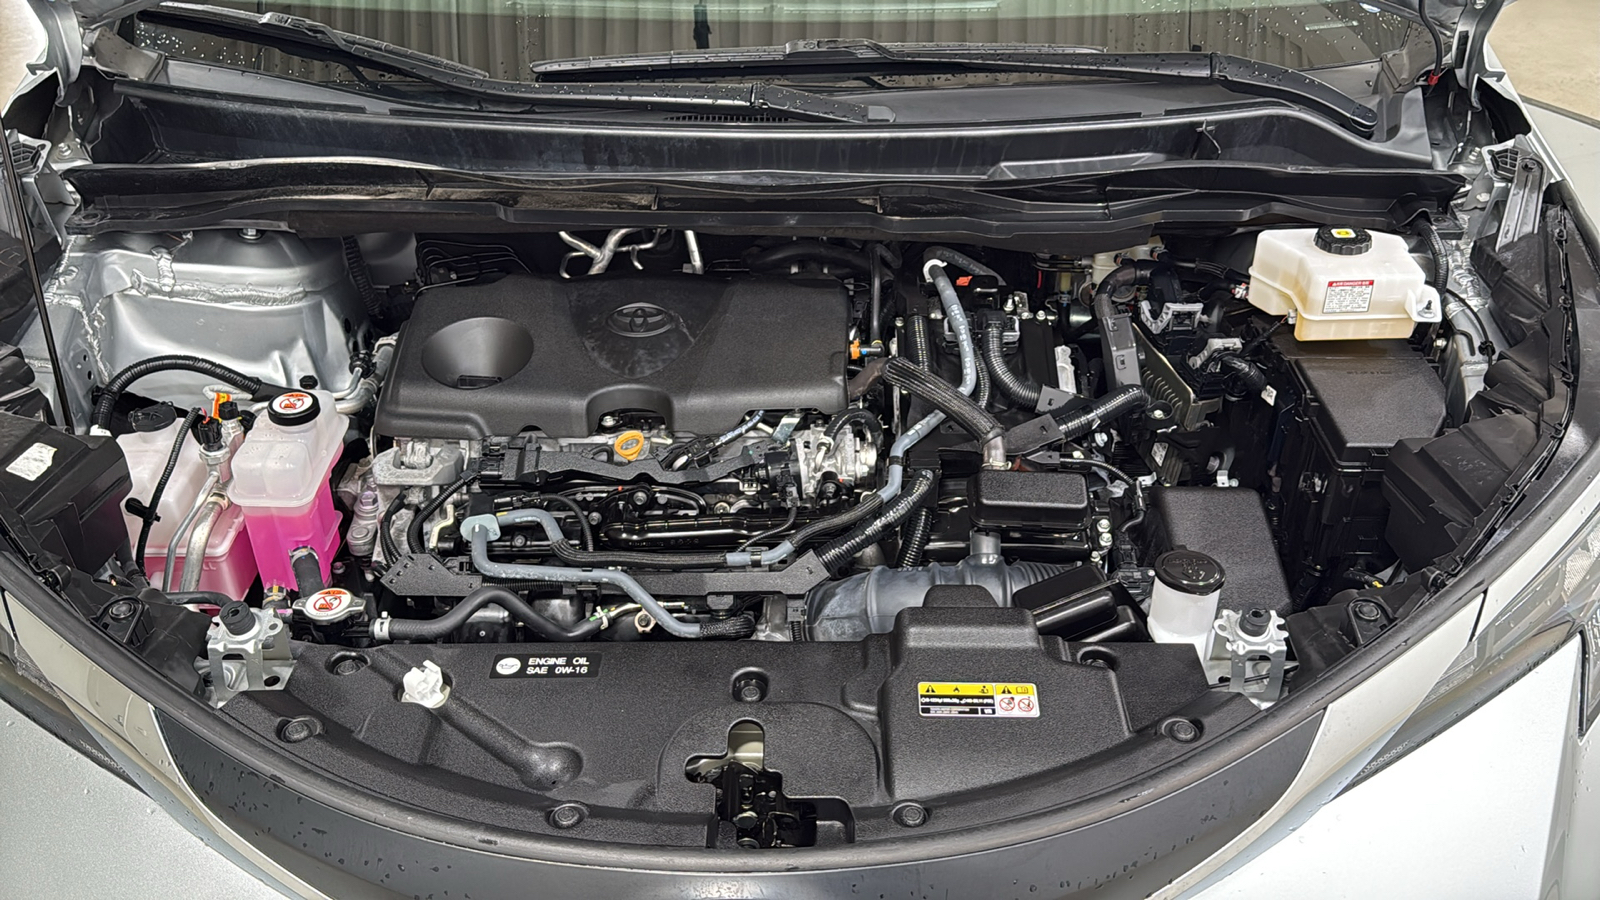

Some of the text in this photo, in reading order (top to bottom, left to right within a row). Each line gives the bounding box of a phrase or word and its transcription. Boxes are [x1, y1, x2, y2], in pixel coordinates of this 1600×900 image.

[528, 657, 589, 665] ENGINE OIL
[554, 666, 588, 674] 0W-16
